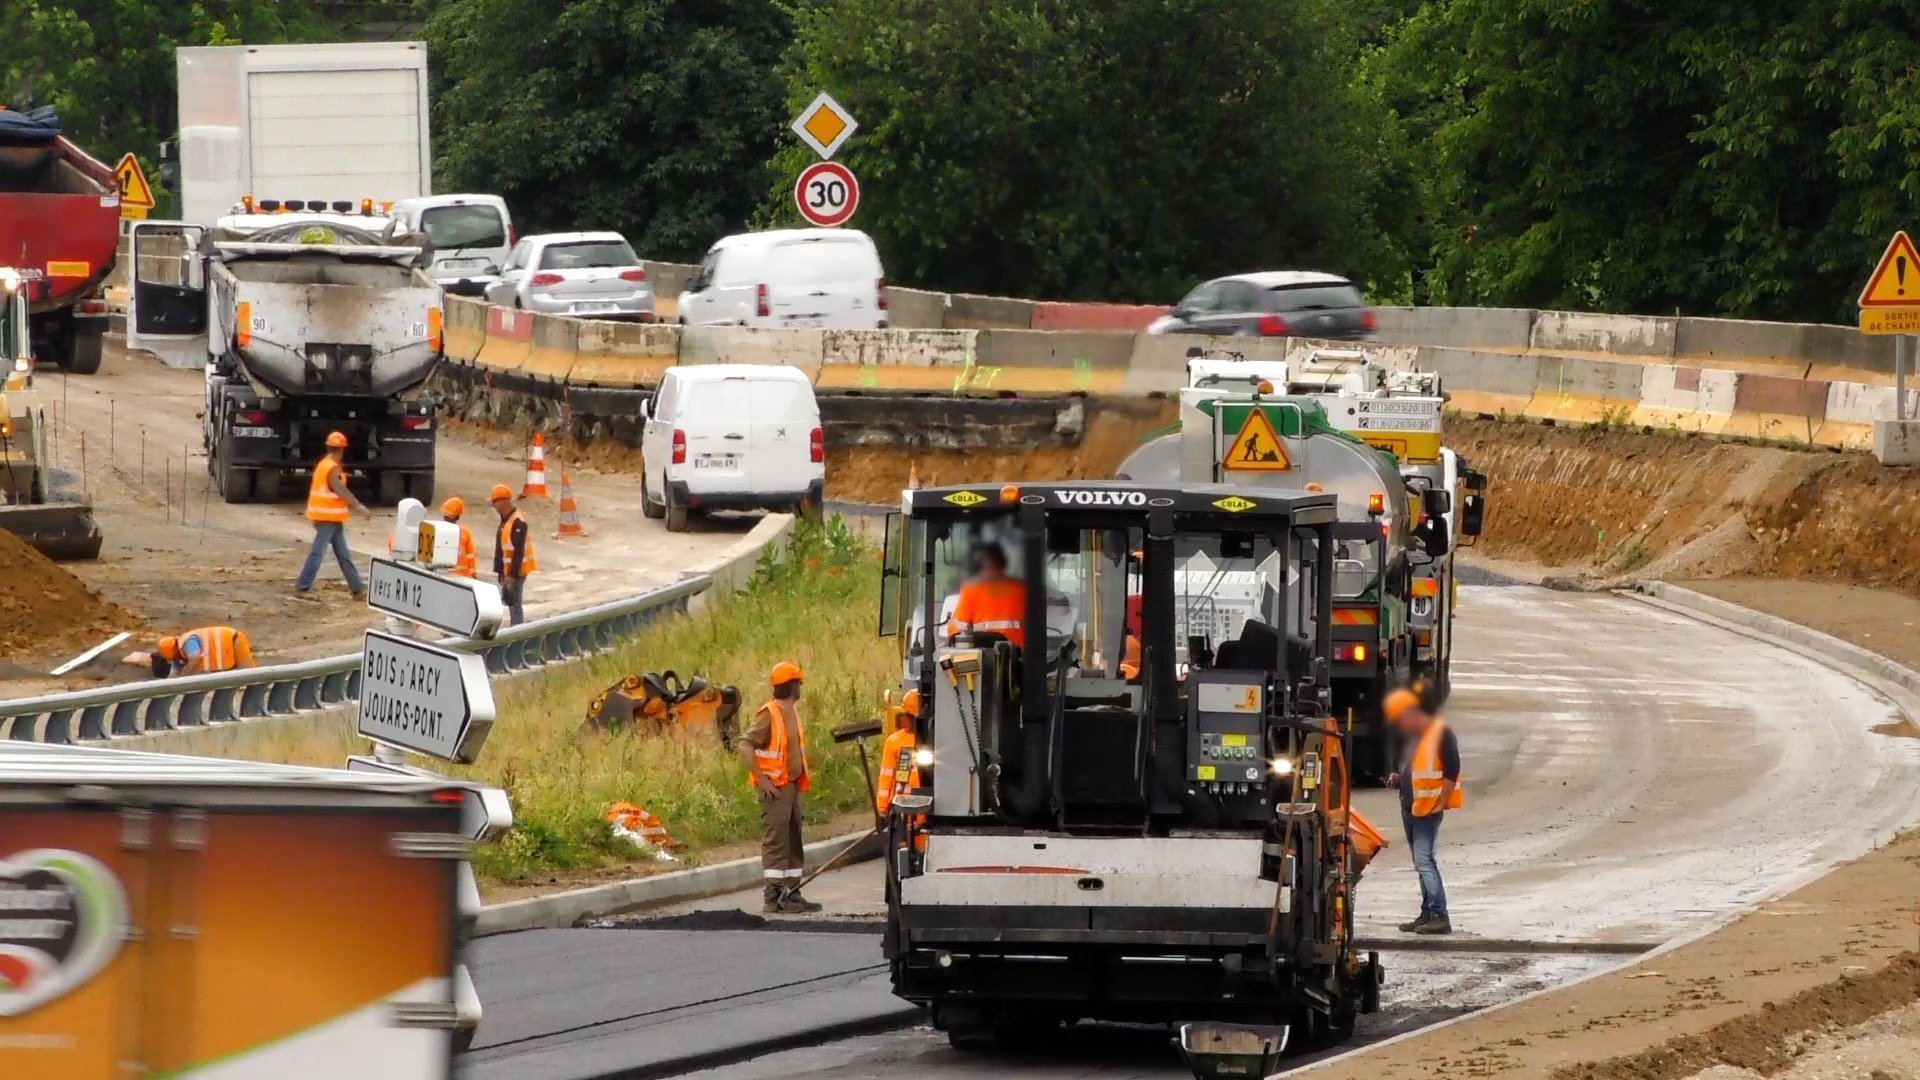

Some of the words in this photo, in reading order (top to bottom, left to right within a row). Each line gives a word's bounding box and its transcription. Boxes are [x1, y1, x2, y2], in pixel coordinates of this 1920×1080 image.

[810, 181, 845, 207] 30
[253, 318, 266, 330] 90
[1885, 312, 1919, 320] SORTIE
[1054, 490, 1146, 506] VOLVO
[374, 577, 391, 599] vers
[395, 578, 409, 603] RN
[412, 583, 423, 608] 12
[1415, 597, 1426, 614] 90
[367, 650, 397, 684] BOIS
